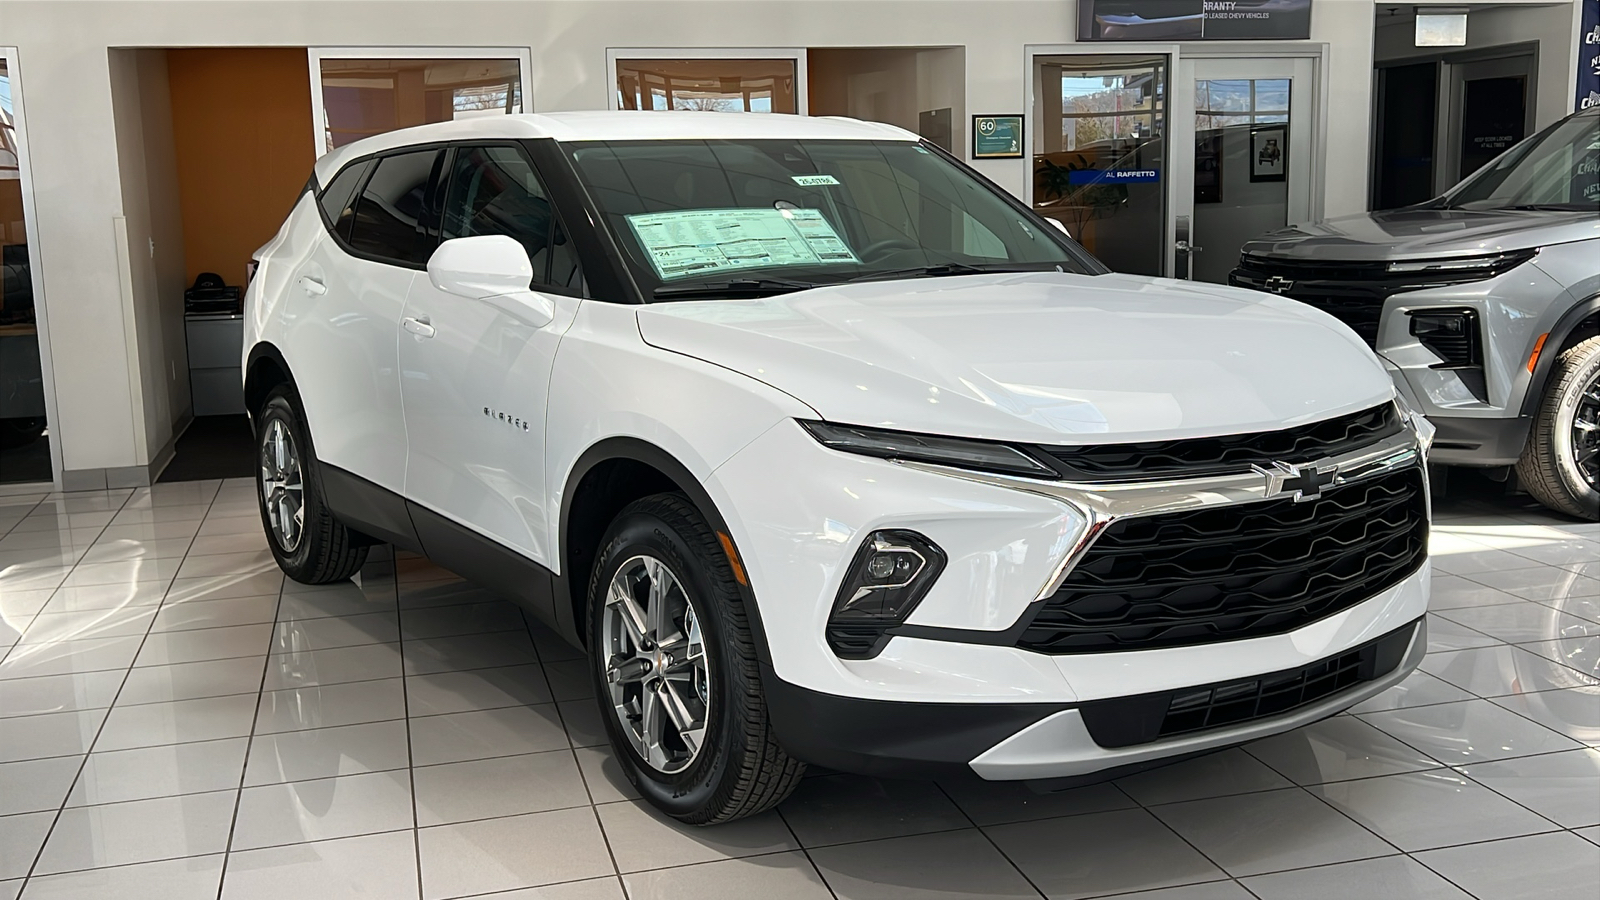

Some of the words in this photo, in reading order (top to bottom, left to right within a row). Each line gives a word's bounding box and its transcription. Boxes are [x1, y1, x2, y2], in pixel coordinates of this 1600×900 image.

[980, 121, 994, 131] 60
[1116, 170, 1155, 178] RAFFETTO
[483, 407, 529, 431] BLAZER
